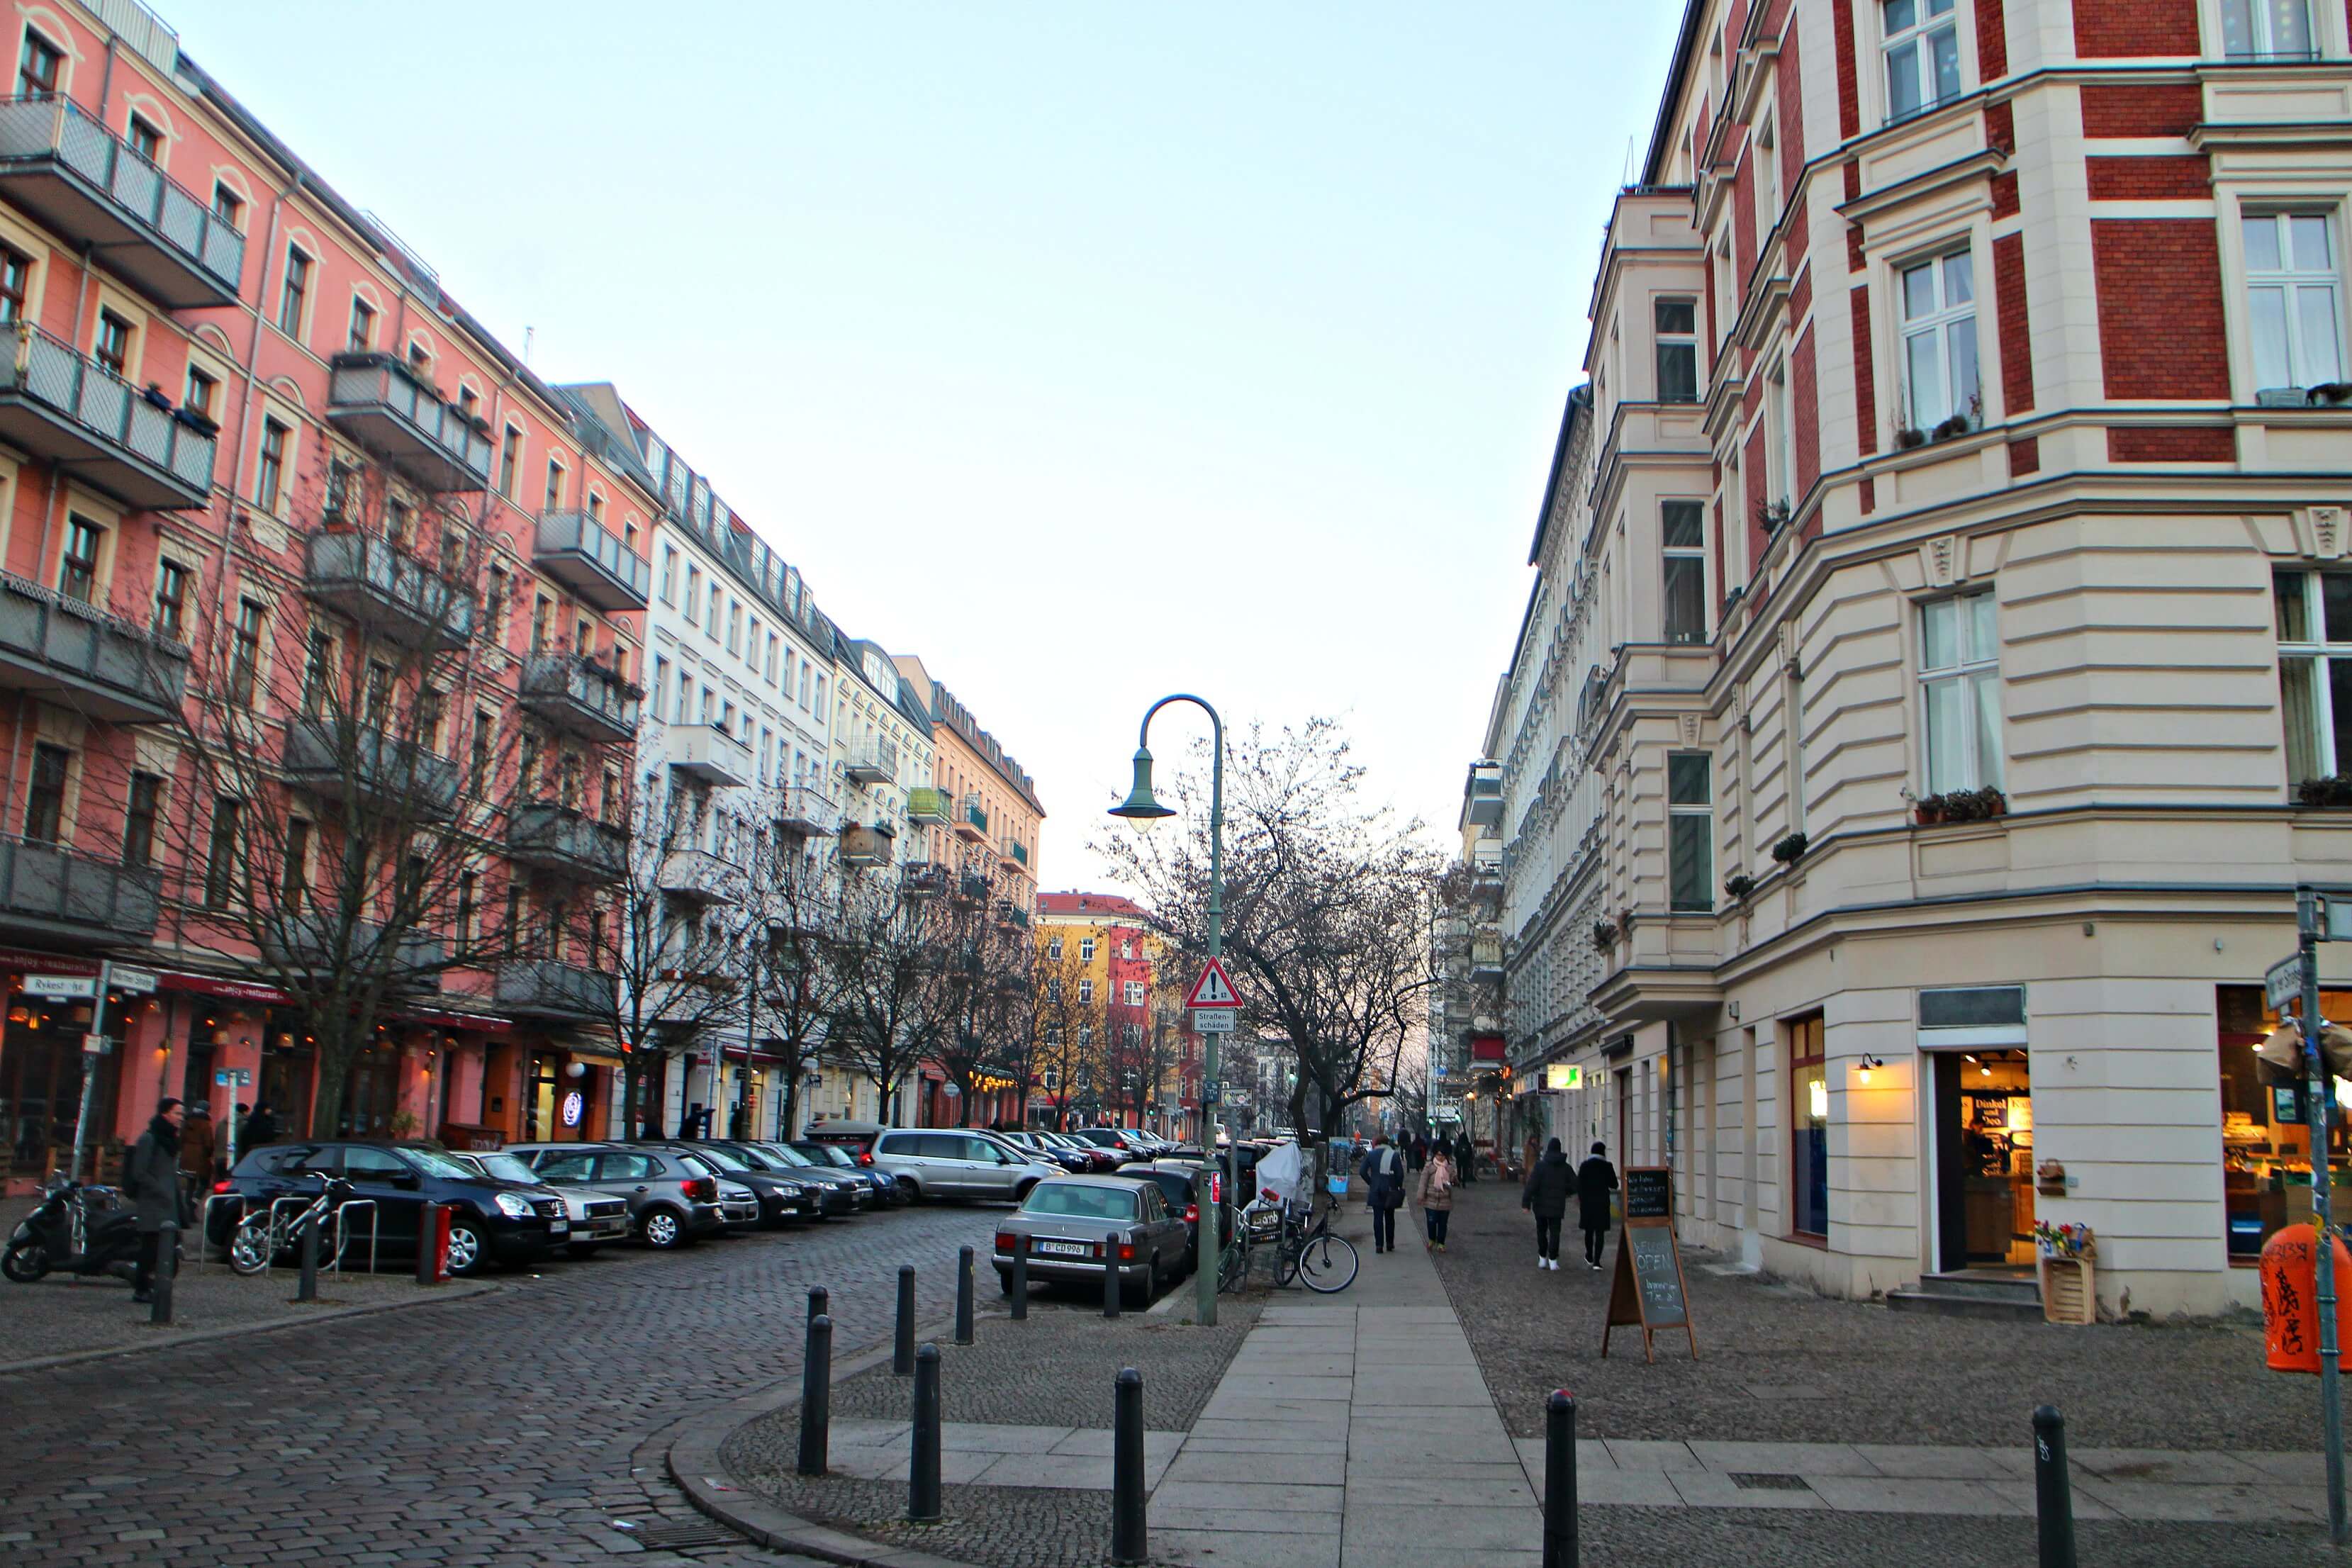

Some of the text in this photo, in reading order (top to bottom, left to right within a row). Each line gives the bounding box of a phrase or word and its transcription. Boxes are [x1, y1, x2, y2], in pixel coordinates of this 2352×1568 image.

[35, 978, 84, 993] Rykestße
[1975, 1099, 2007, 1109] Dinkel
[1637, 1253, 1671, 1270] OPEN
